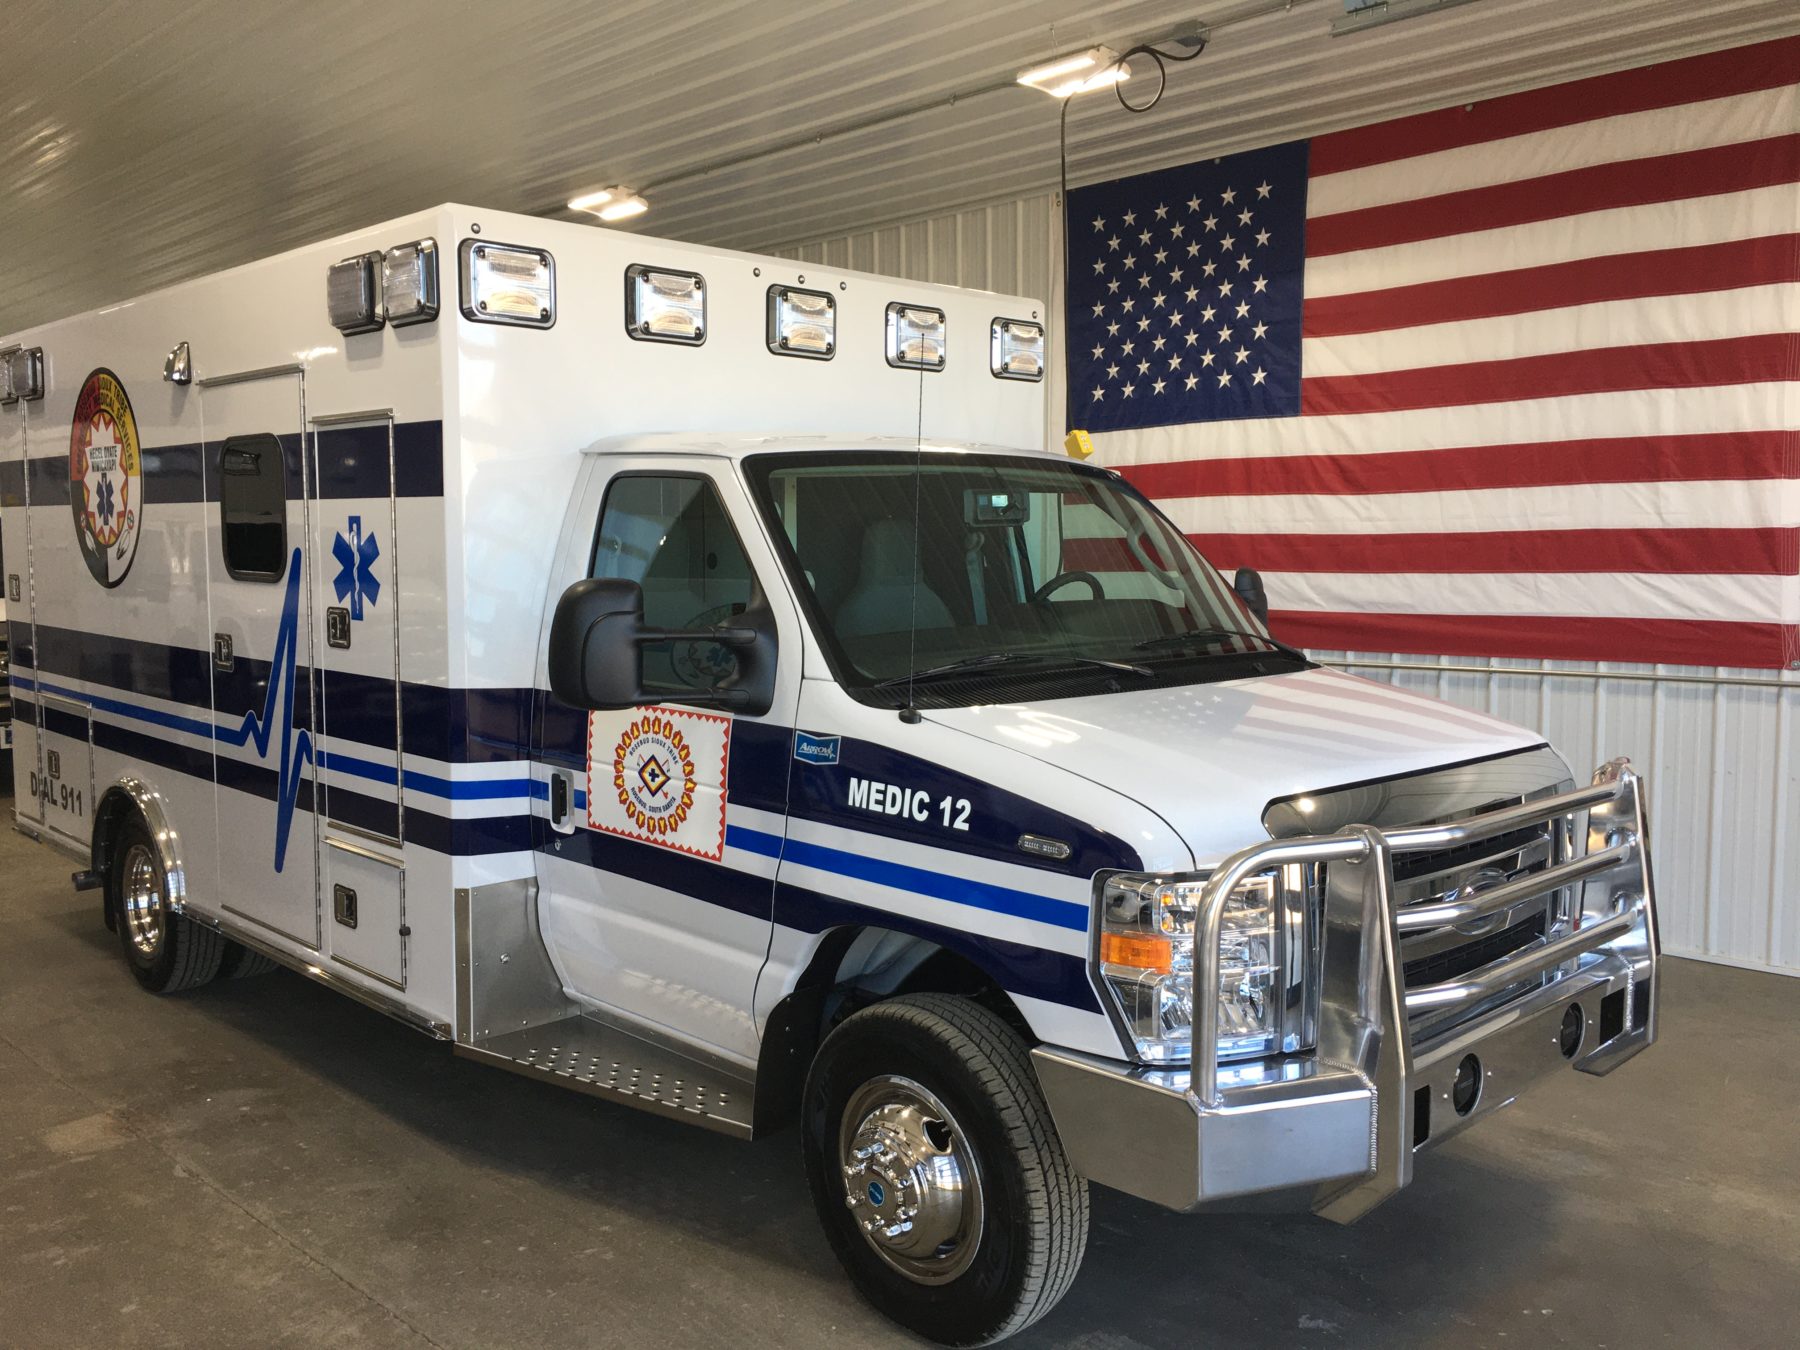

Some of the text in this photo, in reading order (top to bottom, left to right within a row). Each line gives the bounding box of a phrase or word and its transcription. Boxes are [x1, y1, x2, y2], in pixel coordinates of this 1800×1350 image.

[116, 406, 134, 471] SERVICES
[629, 737, 679, 764] ROSEBUD SIOUX TRIBE
[31, 771, 82, 817] DAL 911
[648, 805, 662, 813] SOUTH
[662, 796, 676, 812] DAKOTA
[848, 777, 972, 831] MEDIC 12
